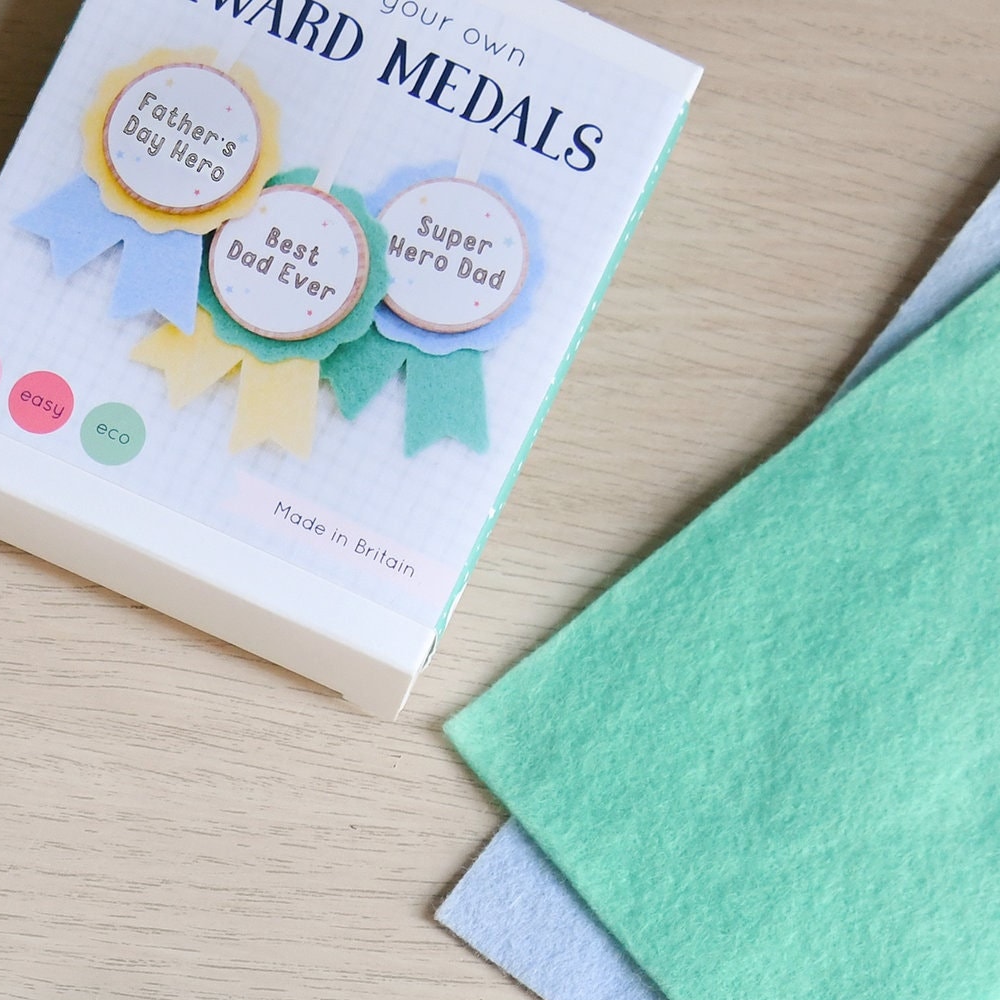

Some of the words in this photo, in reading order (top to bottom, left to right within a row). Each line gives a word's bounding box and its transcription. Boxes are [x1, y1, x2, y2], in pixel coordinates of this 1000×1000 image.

[463, 28, 526, 67] own
[137, 91, 238, 158] Father's
[376, 36, 604, 173] MEDALS
[122, 114, 167, 157] Day
[169, 139, 226, 182] Hero
[265, 226, 321, 268] Best
[388, 234, 449, 272] Hero
[456, 256, 506, 291] Dad
[417, 215, 493, 255] Super
[226, 239, 273, 274] Dad
[277, 262, 336, 301] Ever
[19, 387, 66, 420] easy
[95, 420, 131, 446] eco
[272, 500, 326, 537] Made
[330, 527, 349, 548] in
[353, 536, 416, 579] Britain
